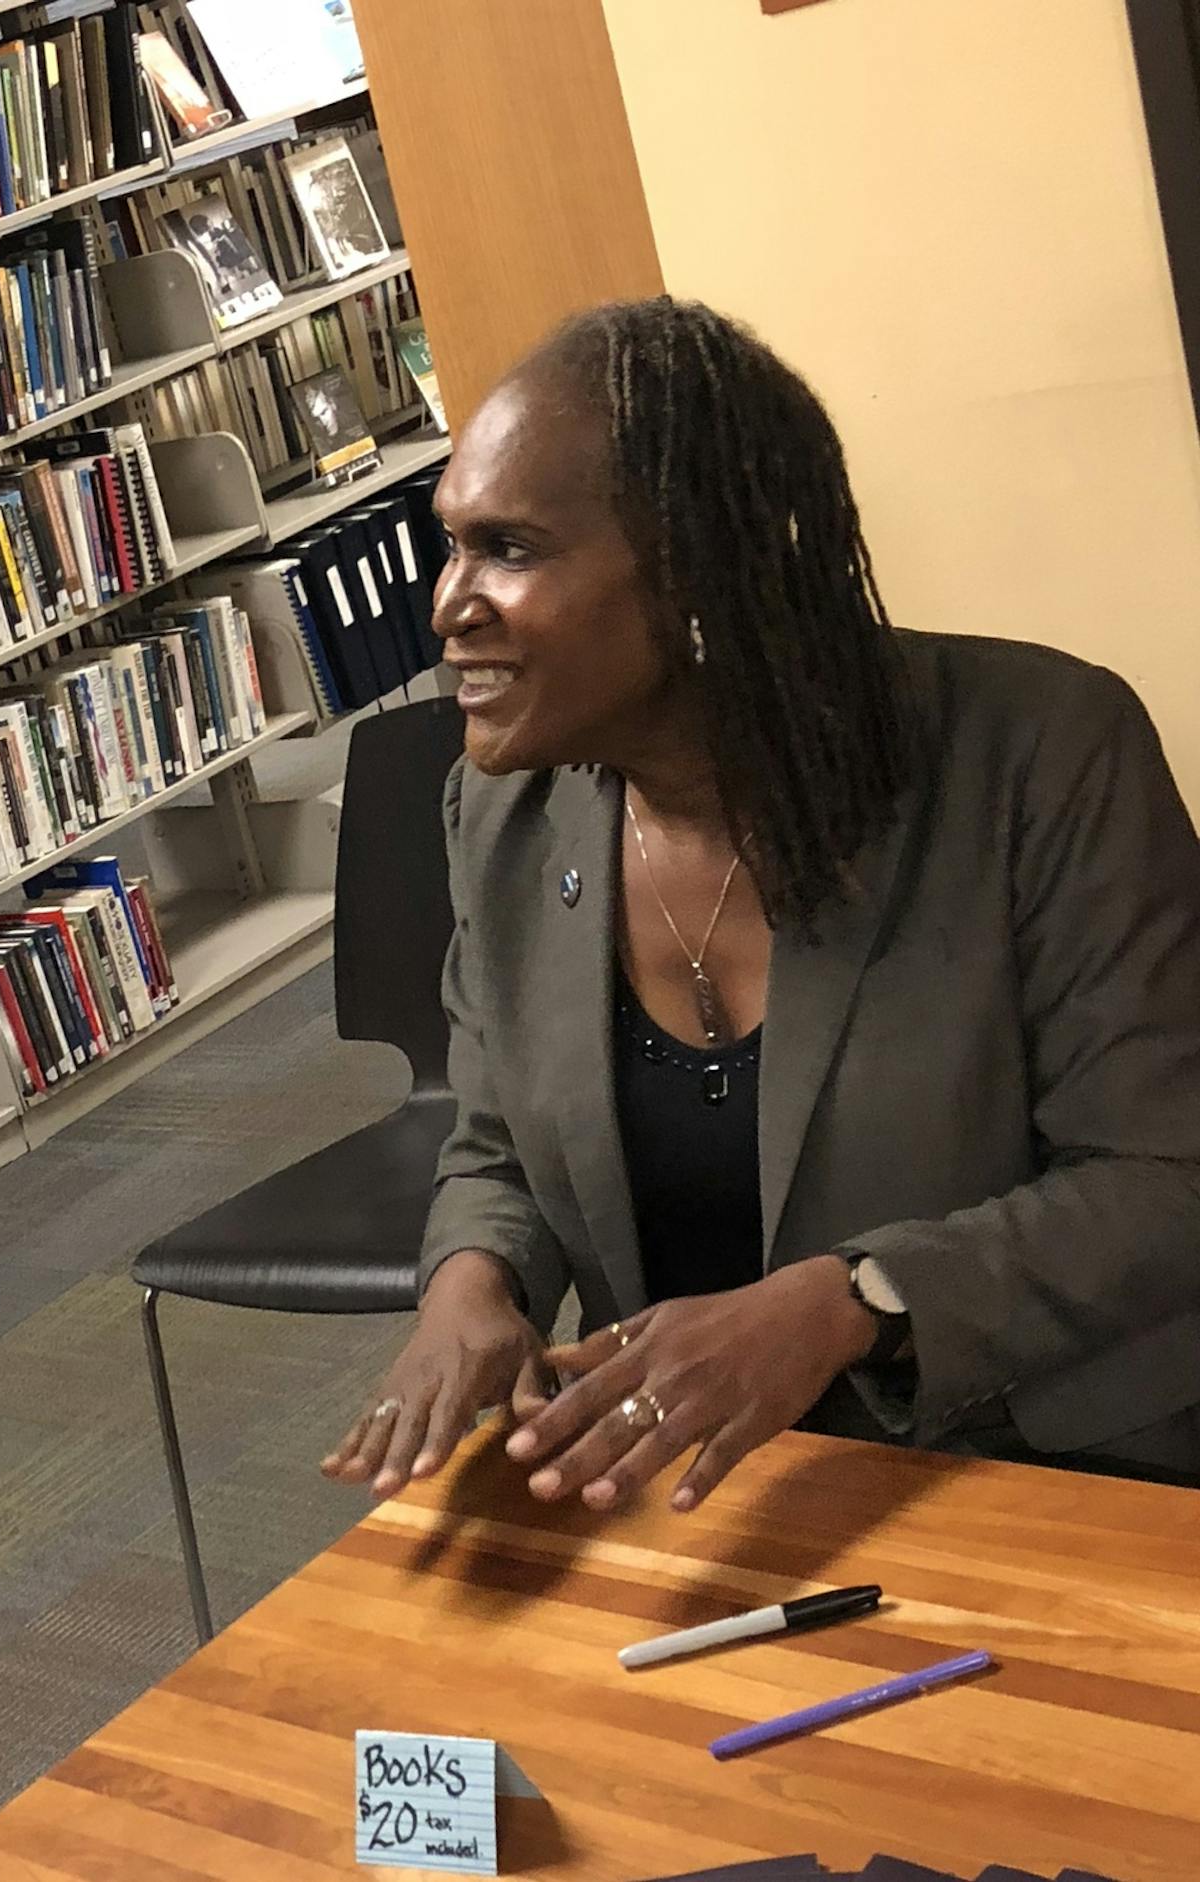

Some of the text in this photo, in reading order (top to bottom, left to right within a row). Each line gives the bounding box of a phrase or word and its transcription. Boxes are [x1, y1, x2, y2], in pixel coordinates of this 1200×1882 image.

[105, 707, 143, 783] EXCLUSION
[105, 892, 138, 979] HOMOSEXUALITY
[364, 1743, 467, 1798] Books
[358, 1788, 452, 1850] $20 tax
